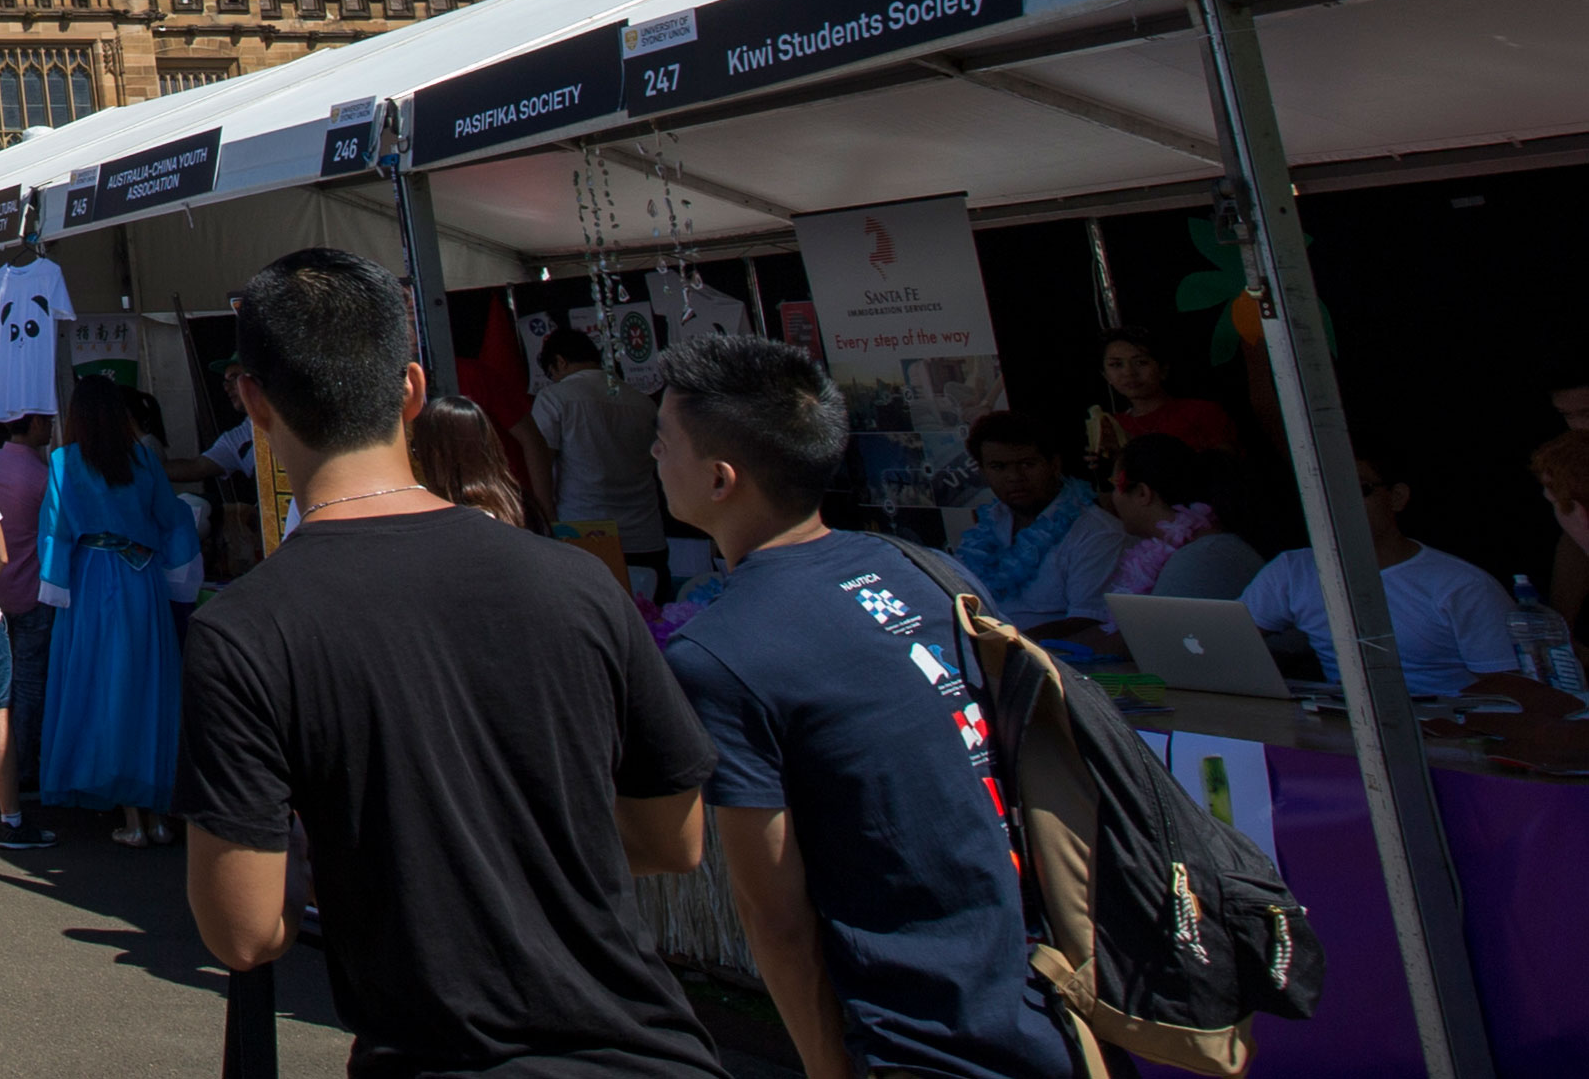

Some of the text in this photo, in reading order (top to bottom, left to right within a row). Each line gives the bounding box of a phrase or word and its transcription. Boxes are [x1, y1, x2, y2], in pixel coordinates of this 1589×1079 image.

[640, 15, 690, 38] UNIVERSITY OF
[641, 26, 691, 48] SYDNEY UNION
[727, 39, 774, 76] Kiwi
[777, 12, 883, 61] Students
[643, 63, 681, 97] 247
[454, 83, 583, 138] PASIFIKA SOCIETY
[333, 137, 359, 162] 246
[107, 159, 177, 190] AUSTRALIA-CHINA
[178, 147, 208, 170] YOUTH
[126, 173, 180, 201] ASSOCIATION
[71, 198, 88, 218] 245
[847, 303, 943, 317] IMMIGRATION SERVICES
[835, 328, 971, 353] Every step of the way
[839, 573, 882, 592] NAUTICA
